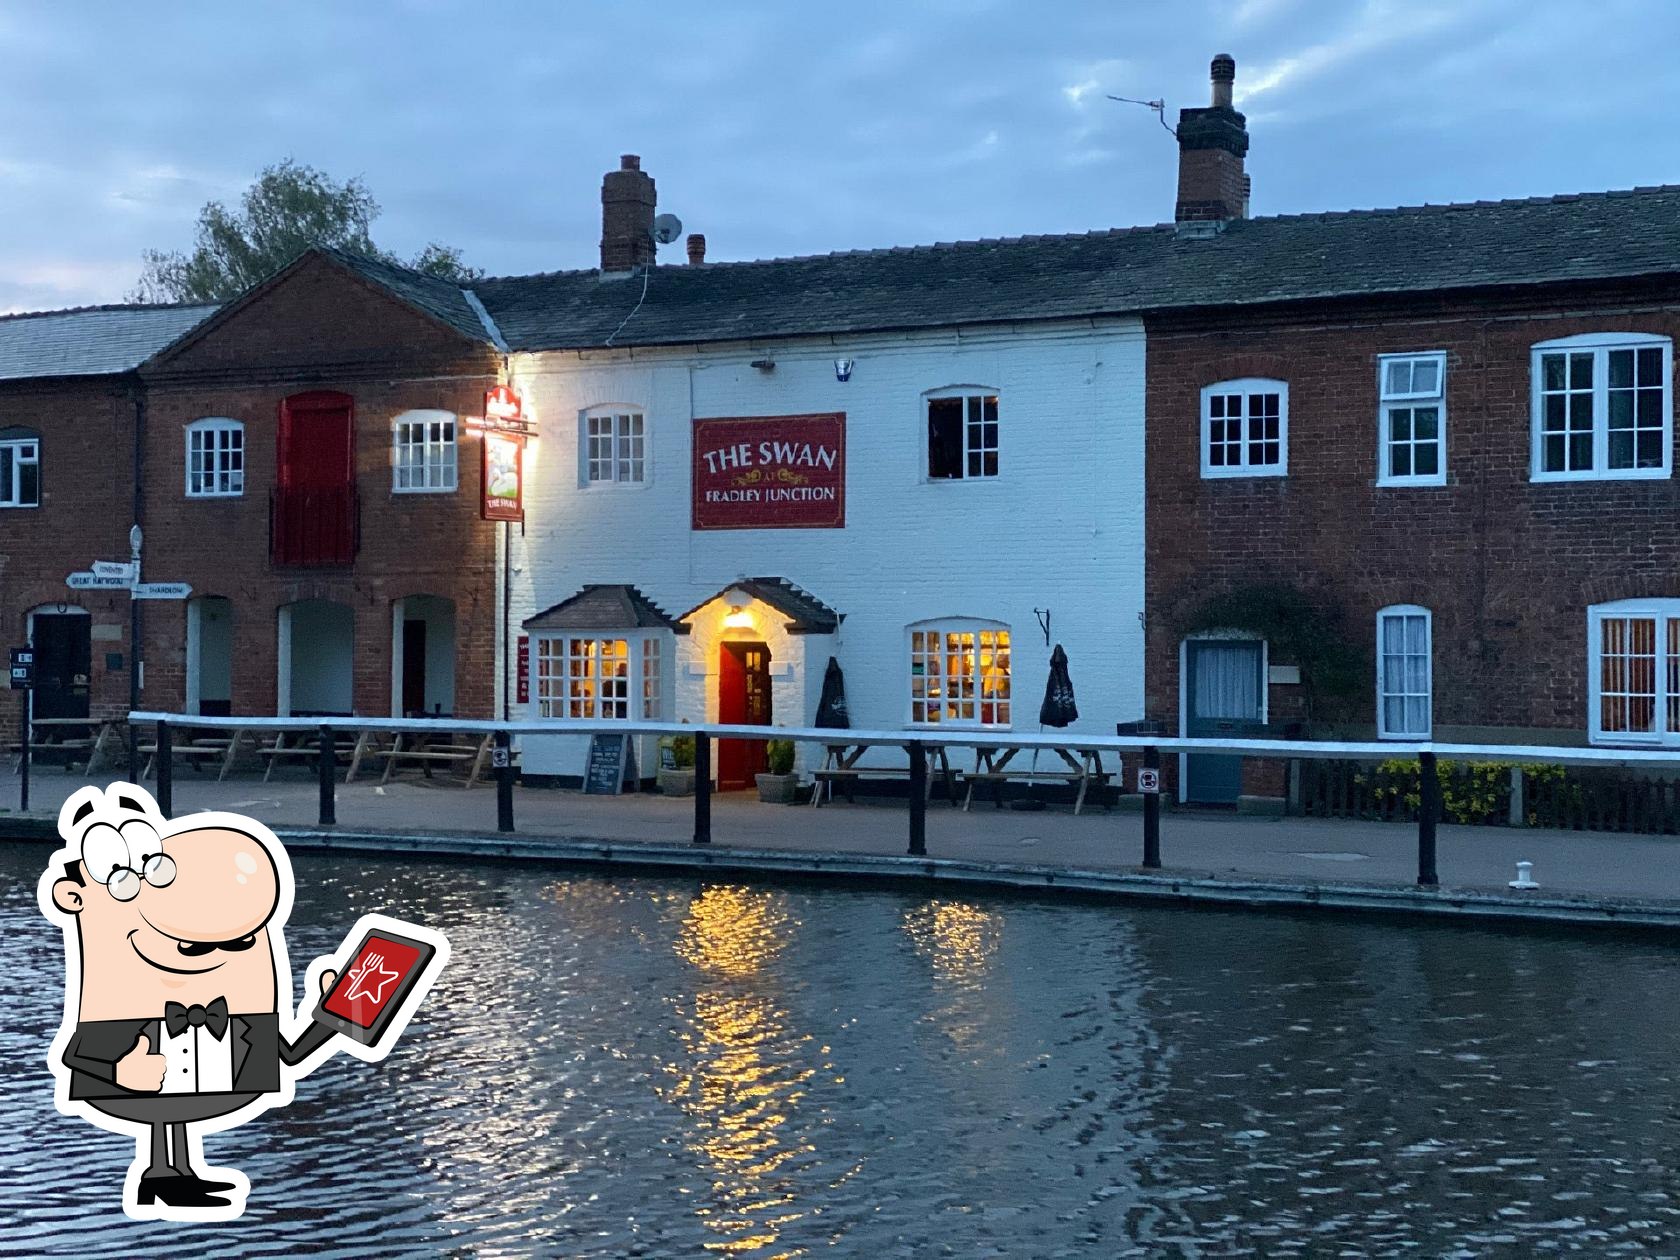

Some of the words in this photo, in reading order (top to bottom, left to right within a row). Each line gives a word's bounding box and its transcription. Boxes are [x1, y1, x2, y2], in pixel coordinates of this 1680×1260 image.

[703, 443, 752, 474] THE
[759, 441, 836, 471] SWAN
[706, 489, 760, 502] FRADLEY
[765, 486, 835, 503] JUNCTION
[487, 498, 500, 509] THE
[501, 498, 516, 511] SWAN
